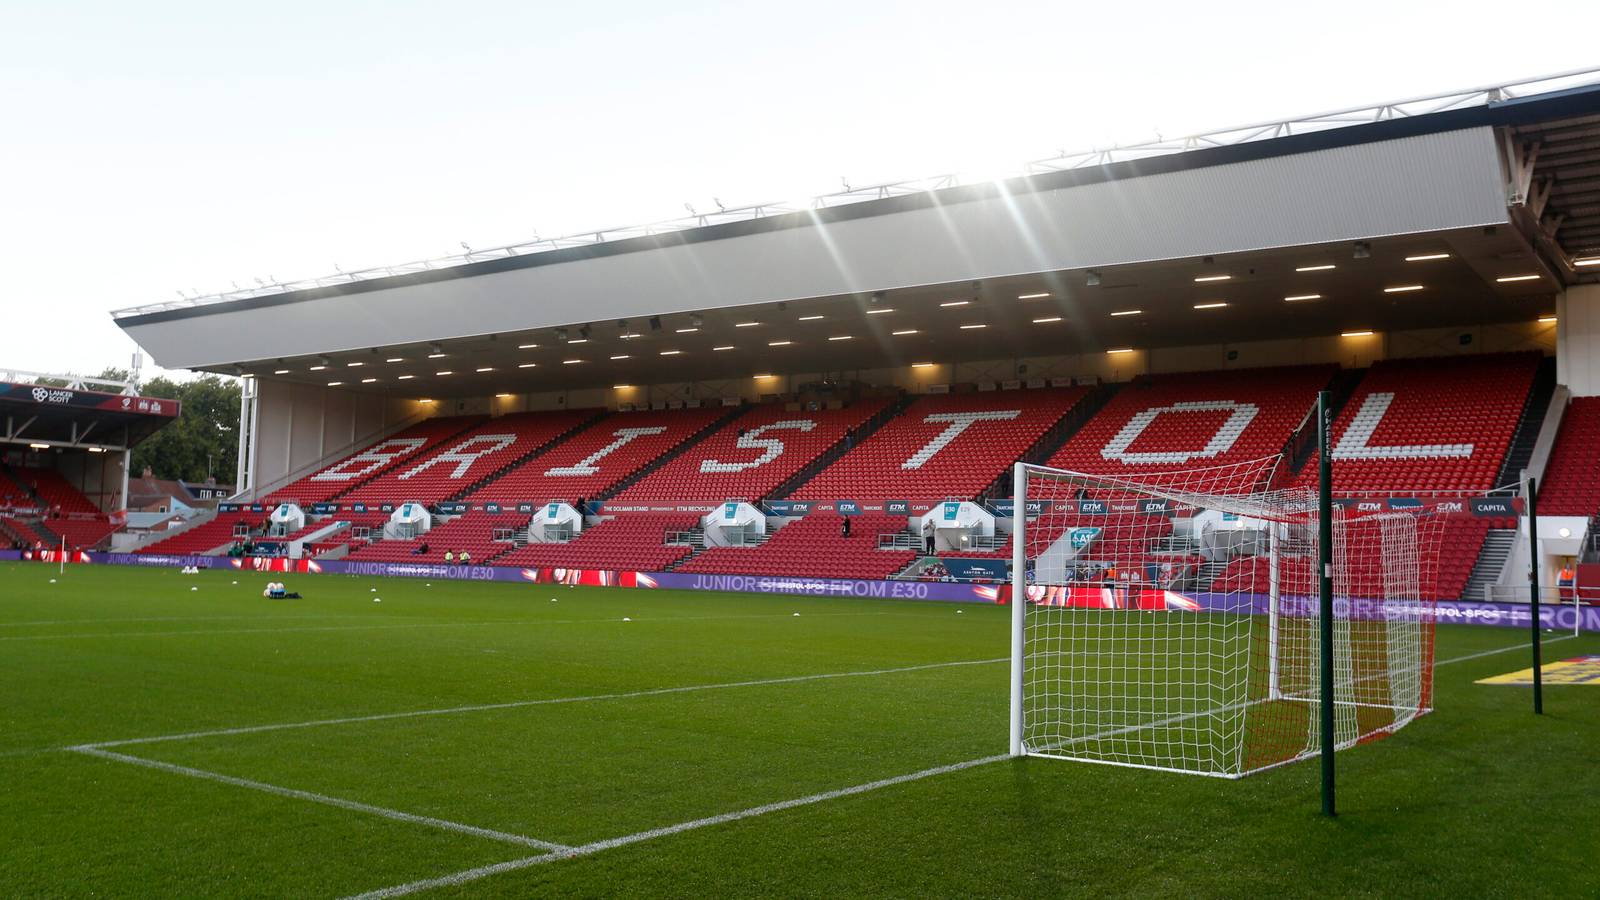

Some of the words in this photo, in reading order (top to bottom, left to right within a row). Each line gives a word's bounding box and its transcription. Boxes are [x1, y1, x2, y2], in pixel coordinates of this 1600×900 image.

[49, 390, 73, 398] LANCER
[49, 396, 70, 404] SCOTT
[310, 392, 1473, 482] BRISTOL
[345, 562, 386, 575] JUNIOR
[434, 565, 468, 578] FROM
[471, 567, 494, 580] £30
[693, 576, 756, 591] JUNIOR
[761, 578, 825, 595] SHIRTS
[831, 580, 886, 597] FROM
[892, 584, 928, 599] £30
